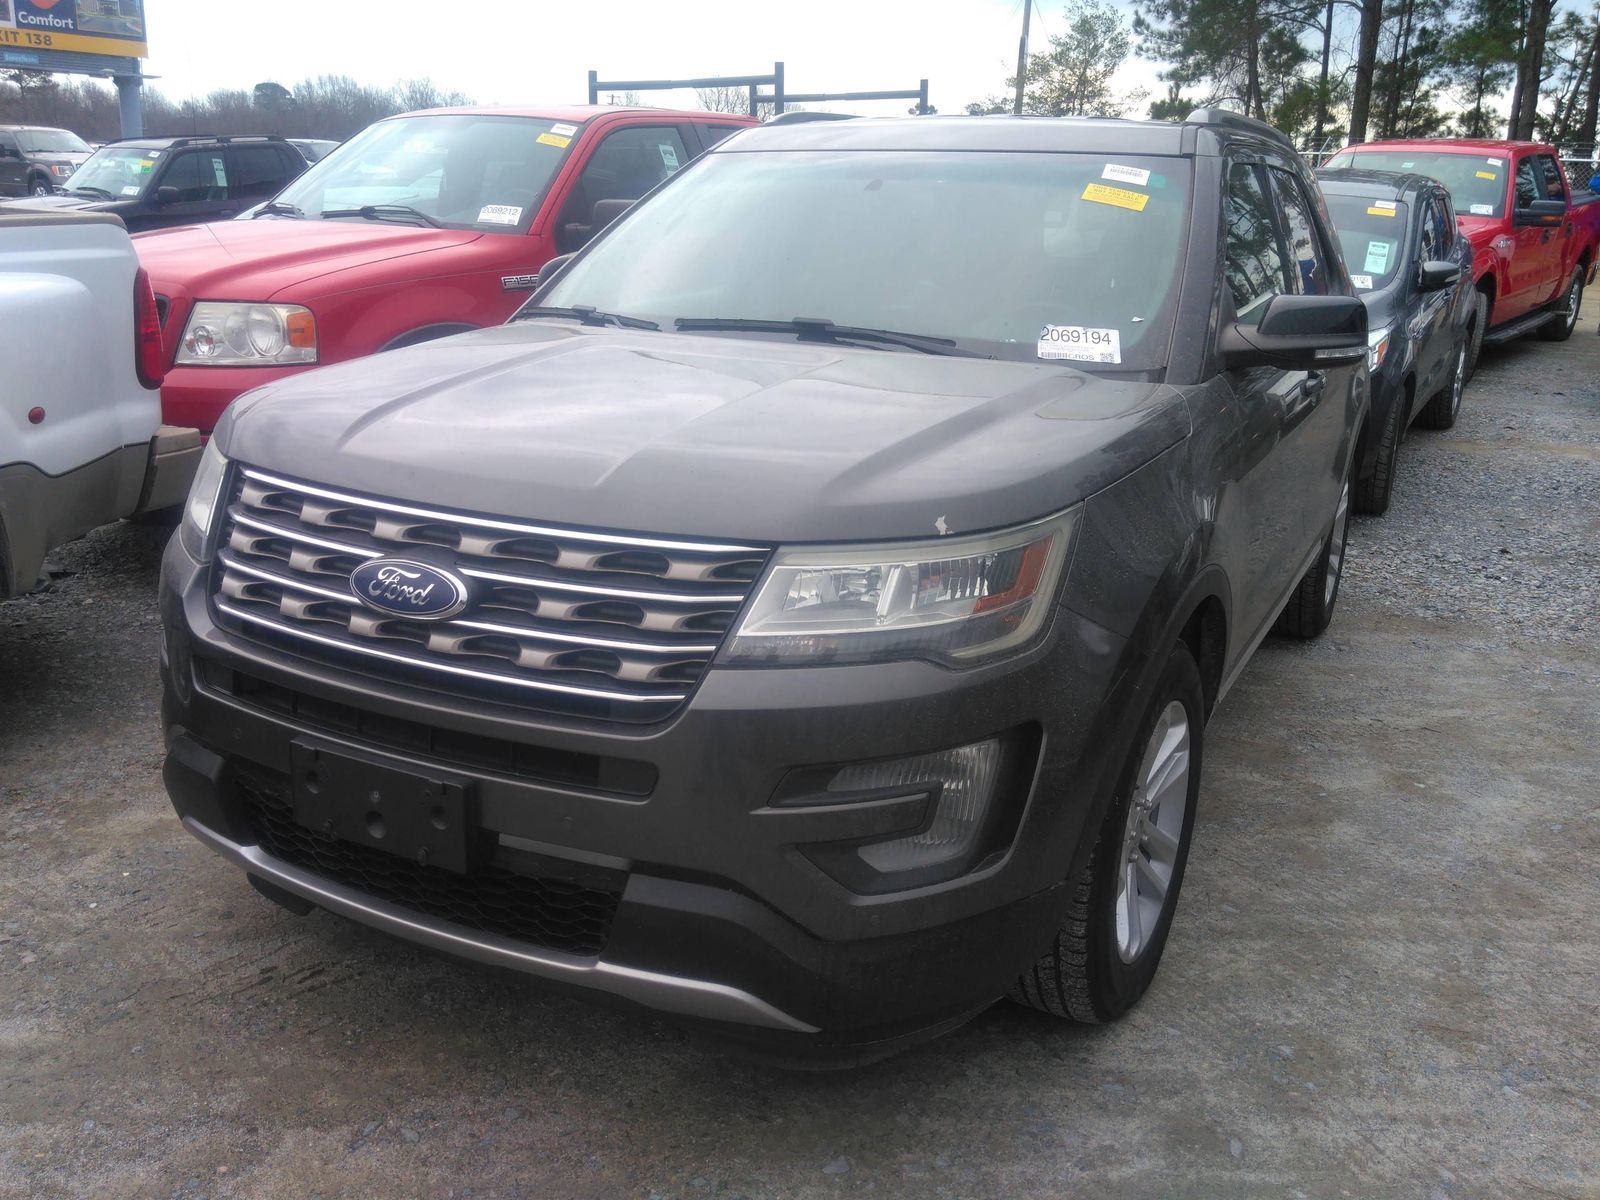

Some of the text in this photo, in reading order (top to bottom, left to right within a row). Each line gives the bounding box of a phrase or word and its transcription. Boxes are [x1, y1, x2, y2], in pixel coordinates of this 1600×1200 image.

[18, 11, 74, 29] Comfort
[25, 33, 52, 46] 138
[482, 206, 519, 216] 2069212
[1041, 326, 1111, 345] 2069194
[368, 566, 434, 606] Ford
